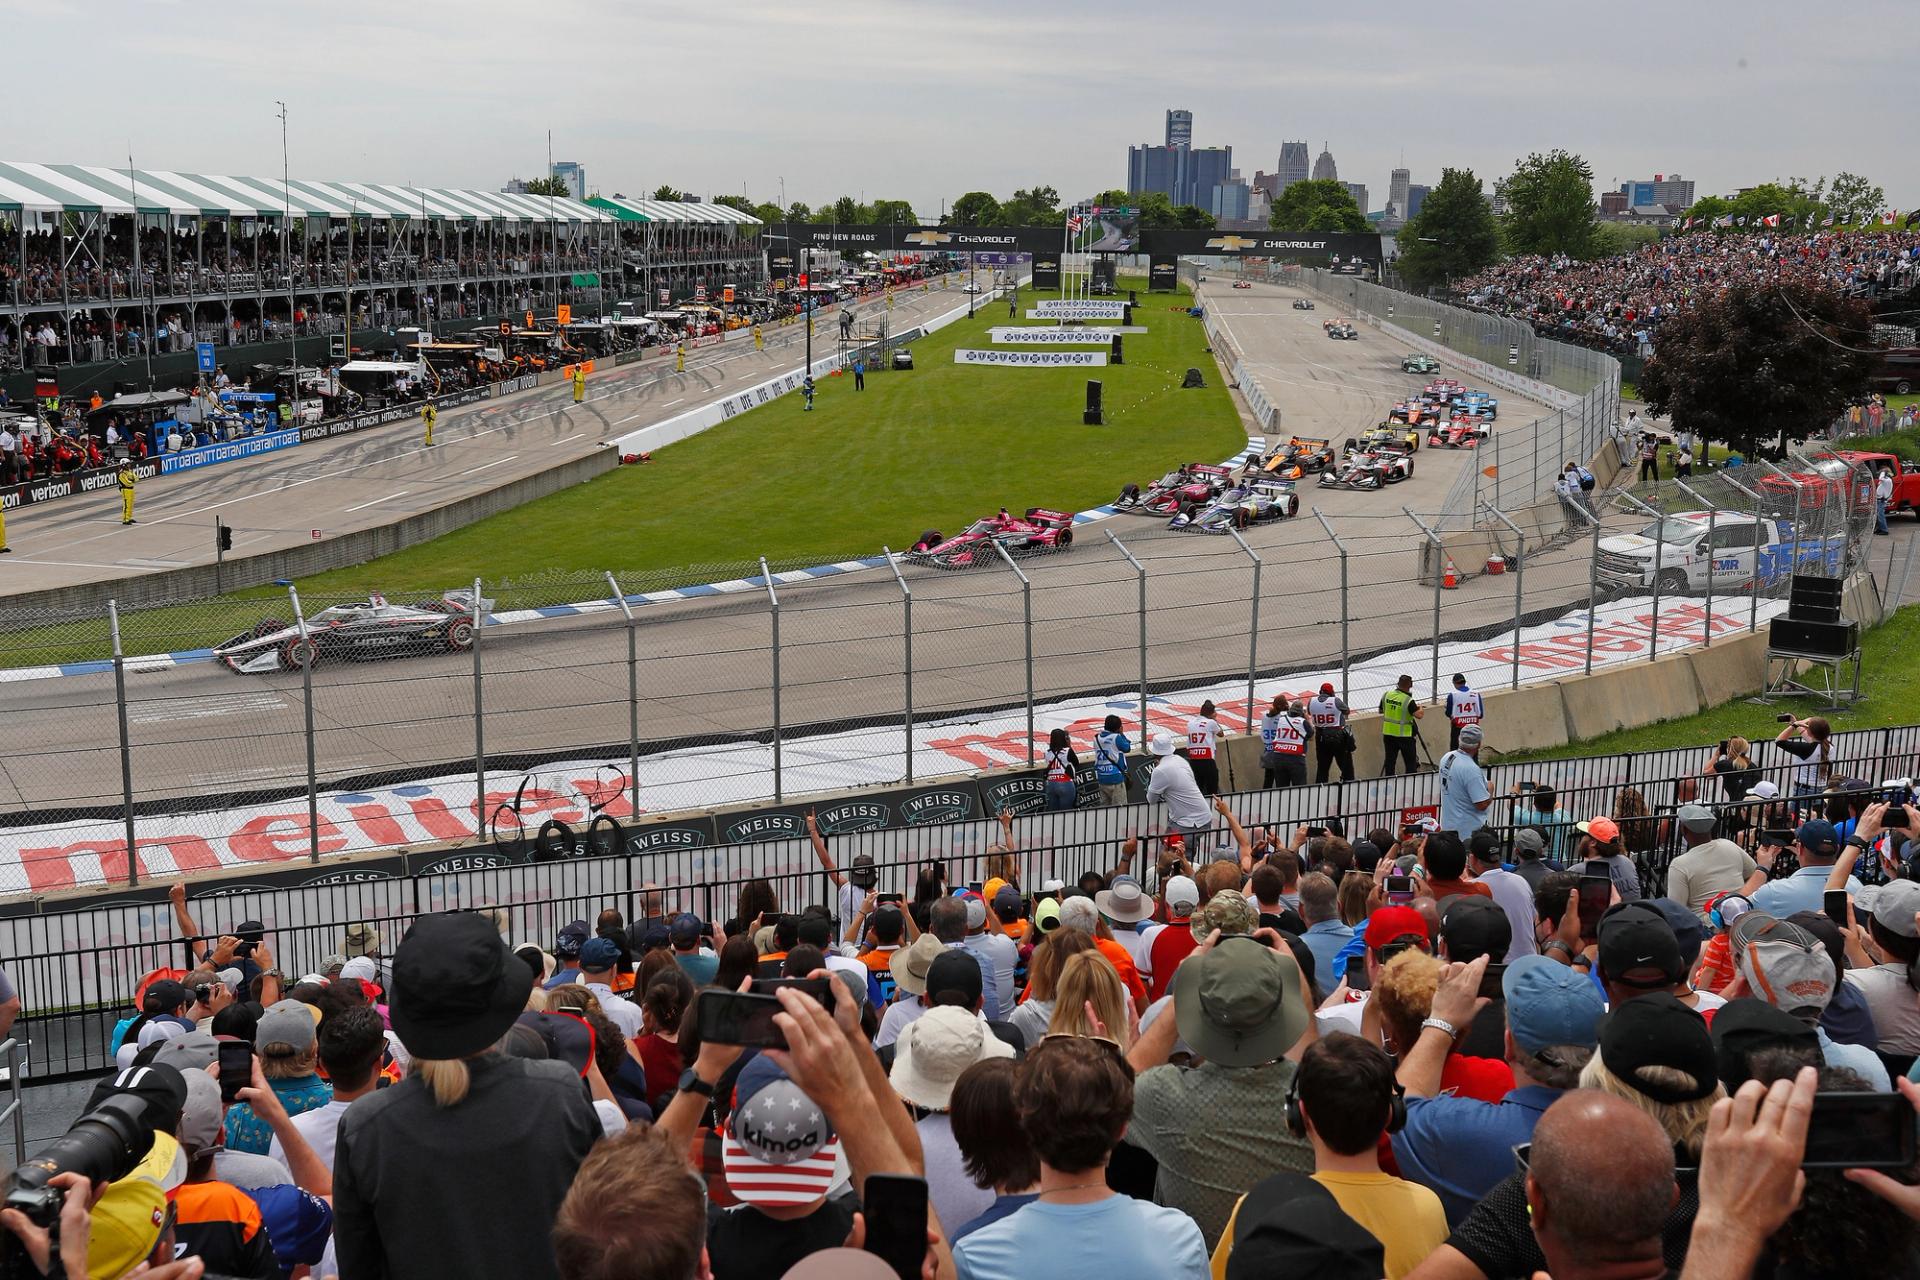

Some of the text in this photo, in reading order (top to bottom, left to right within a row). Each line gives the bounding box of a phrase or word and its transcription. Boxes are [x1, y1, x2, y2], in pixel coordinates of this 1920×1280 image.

[851, 233, 875, 241] ROADS
[958, 235, 1016, 243] CHEVROLET
[1263, 240, 1326, 249] CHEVROLET
[560, 309, 569, 320] 7
[501, 323, 510, 335] 5
[356, 414, 379, 429] HITACHI
[381, 408, 401, 422] HITACHI
[302, 425, 327, 441] HITACHI
[330, 420, 354, 434] HITACHI
[81, 472, 118, 491] verizon
[31, 482, 71, 502] verizon
[1457, 702, 1477, 714] 141
[1457, 717, 1479, 725] PHOTO
[1276, 727, 1300, 740] 170
[1274, 743, 1298, 752] PHOTO
[996, 779, 1044, 797] WEISS
[910, 794, 960, 811] WEISS
[826, 805, 879, 823] WEISS
[1406, 811, 1432, 822] Section
[19, 774, 646, 892] meijer
[737, 818, 793, 835] WEISS
[634, 832, 692, 850] WEISS
[433, 856, 497, 874] WEISS
[743, 1122, 819, 1154] kimoa
